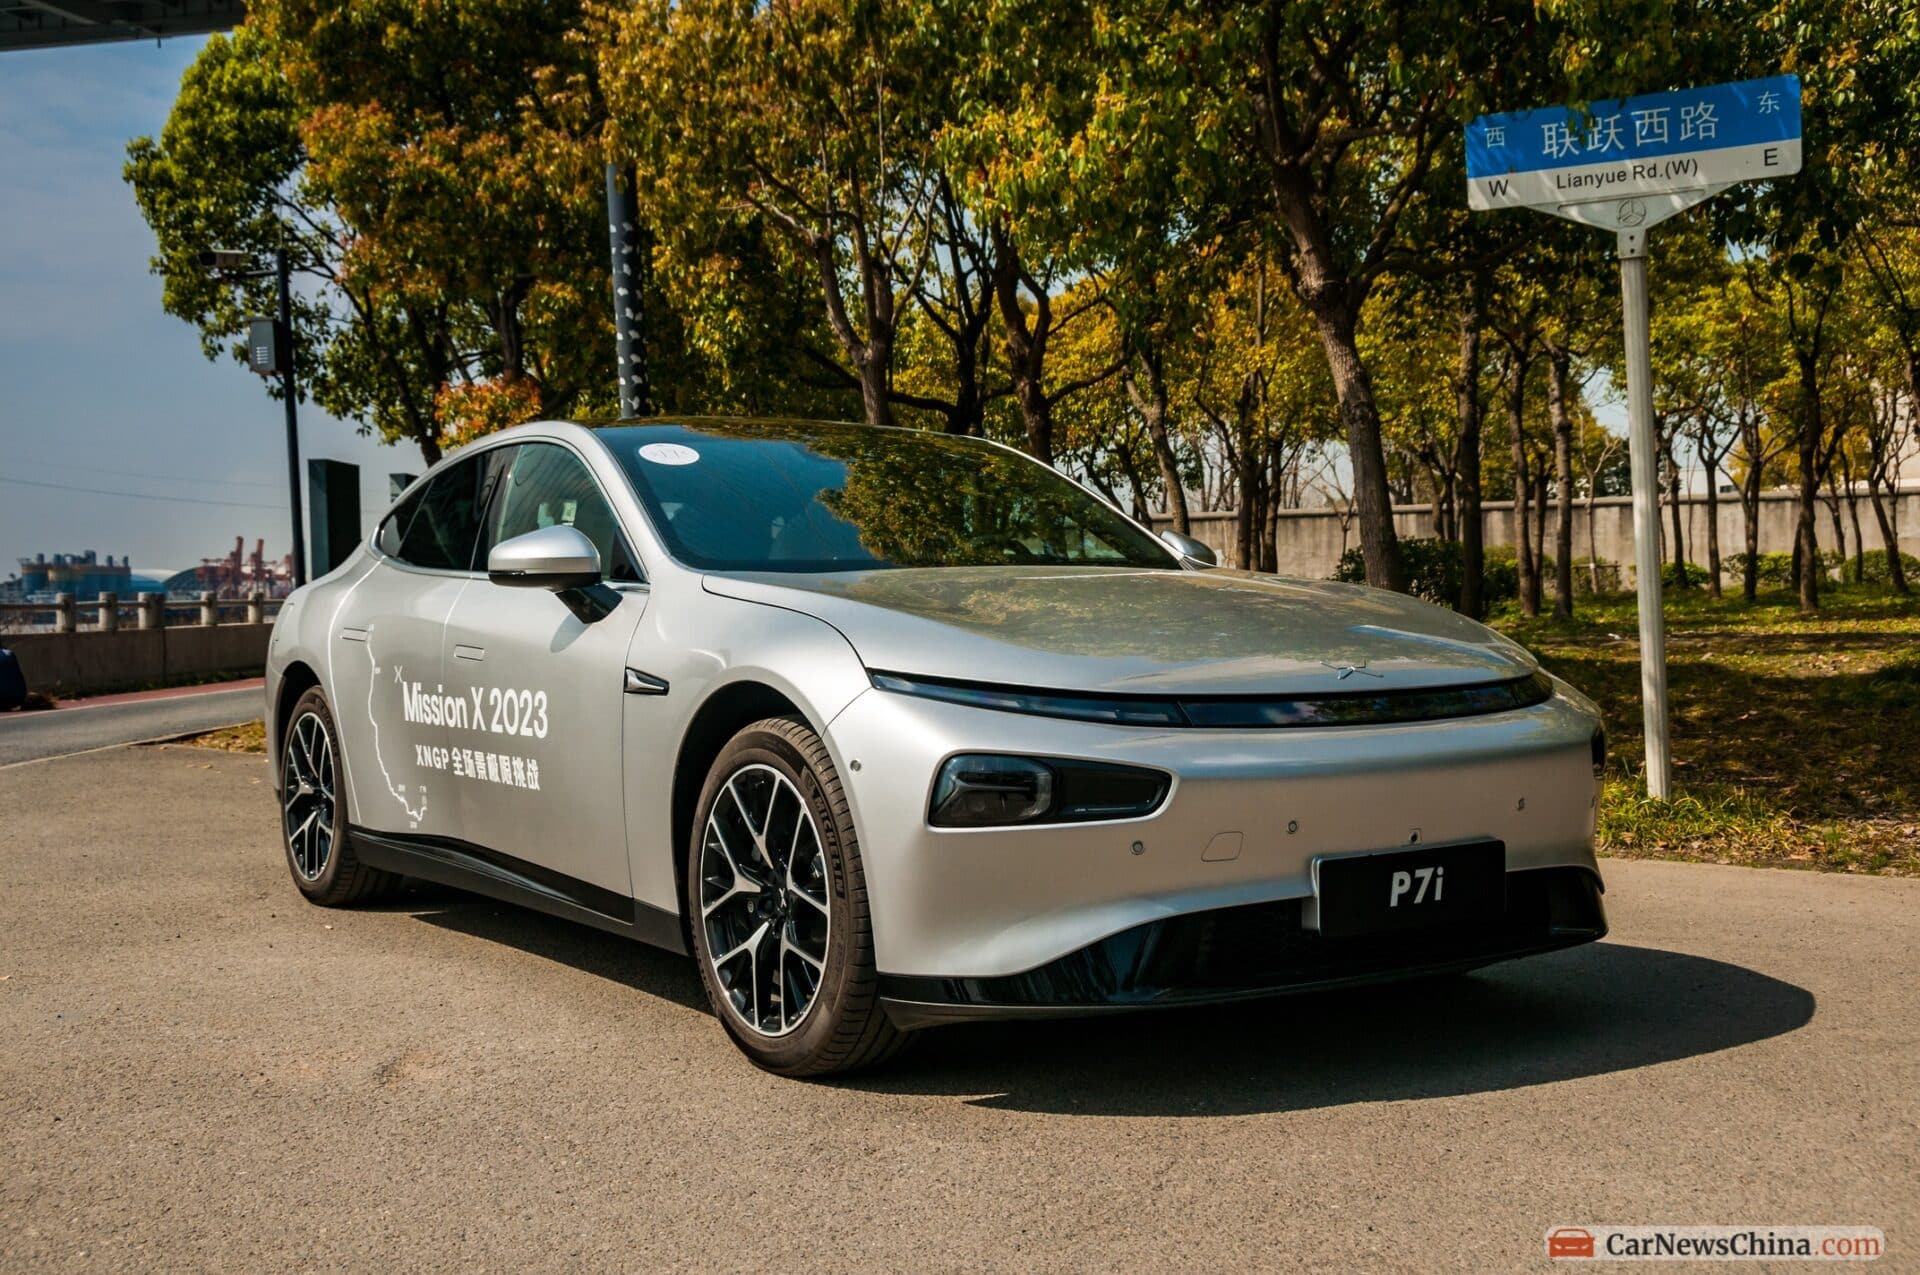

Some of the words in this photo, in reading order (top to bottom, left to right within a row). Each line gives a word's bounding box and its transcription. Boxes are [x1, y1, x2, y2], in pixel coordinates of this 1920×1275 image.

[1756, 91, 1781, 114] 东
[1485, 126, 1506, 148] 西
[1541, 101, 1719, 160] 联跃西路
[1763, 148, 1779, 167] E
[1556, 169, 1627, 190] Lianyue
[1632, 157, 1698, 181] Rd.(W)
[1488, 179, 1509, 197] W
[403, 681, 468, 729] Mission
[471, 686, 487, 732] X
[489, 687, 549, 739] 2023
[415, 744, 449, 770] XNGP
[1390, 866, 1444, 907] P7i
